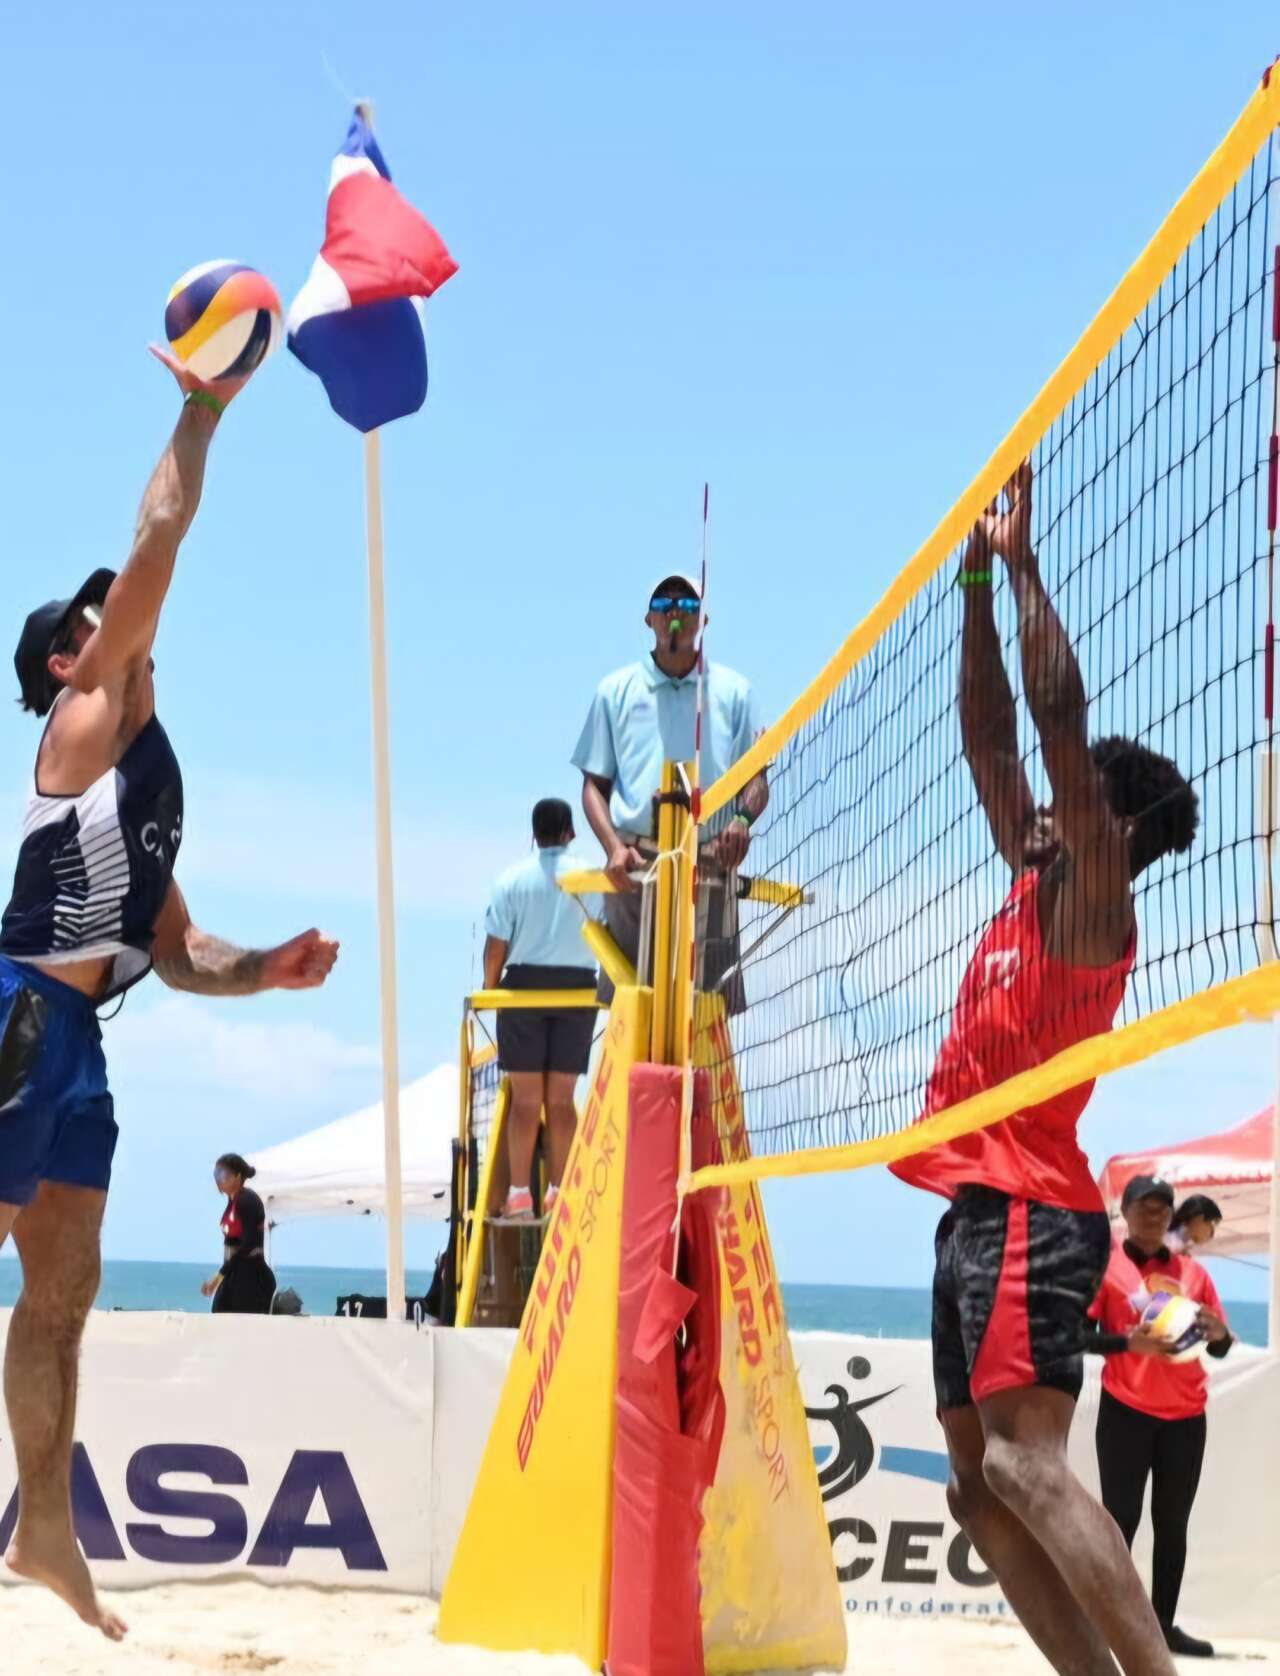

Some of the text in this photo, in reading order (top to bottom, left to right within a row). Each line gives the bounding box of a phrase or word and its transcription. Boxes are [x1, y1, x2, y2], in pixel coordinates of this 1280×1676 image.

[580, 1105, 620, 1243] SPORT
[754, 1376, 790, 1502] SPORT
[845, 1595, 1006, 1615] onfederat
